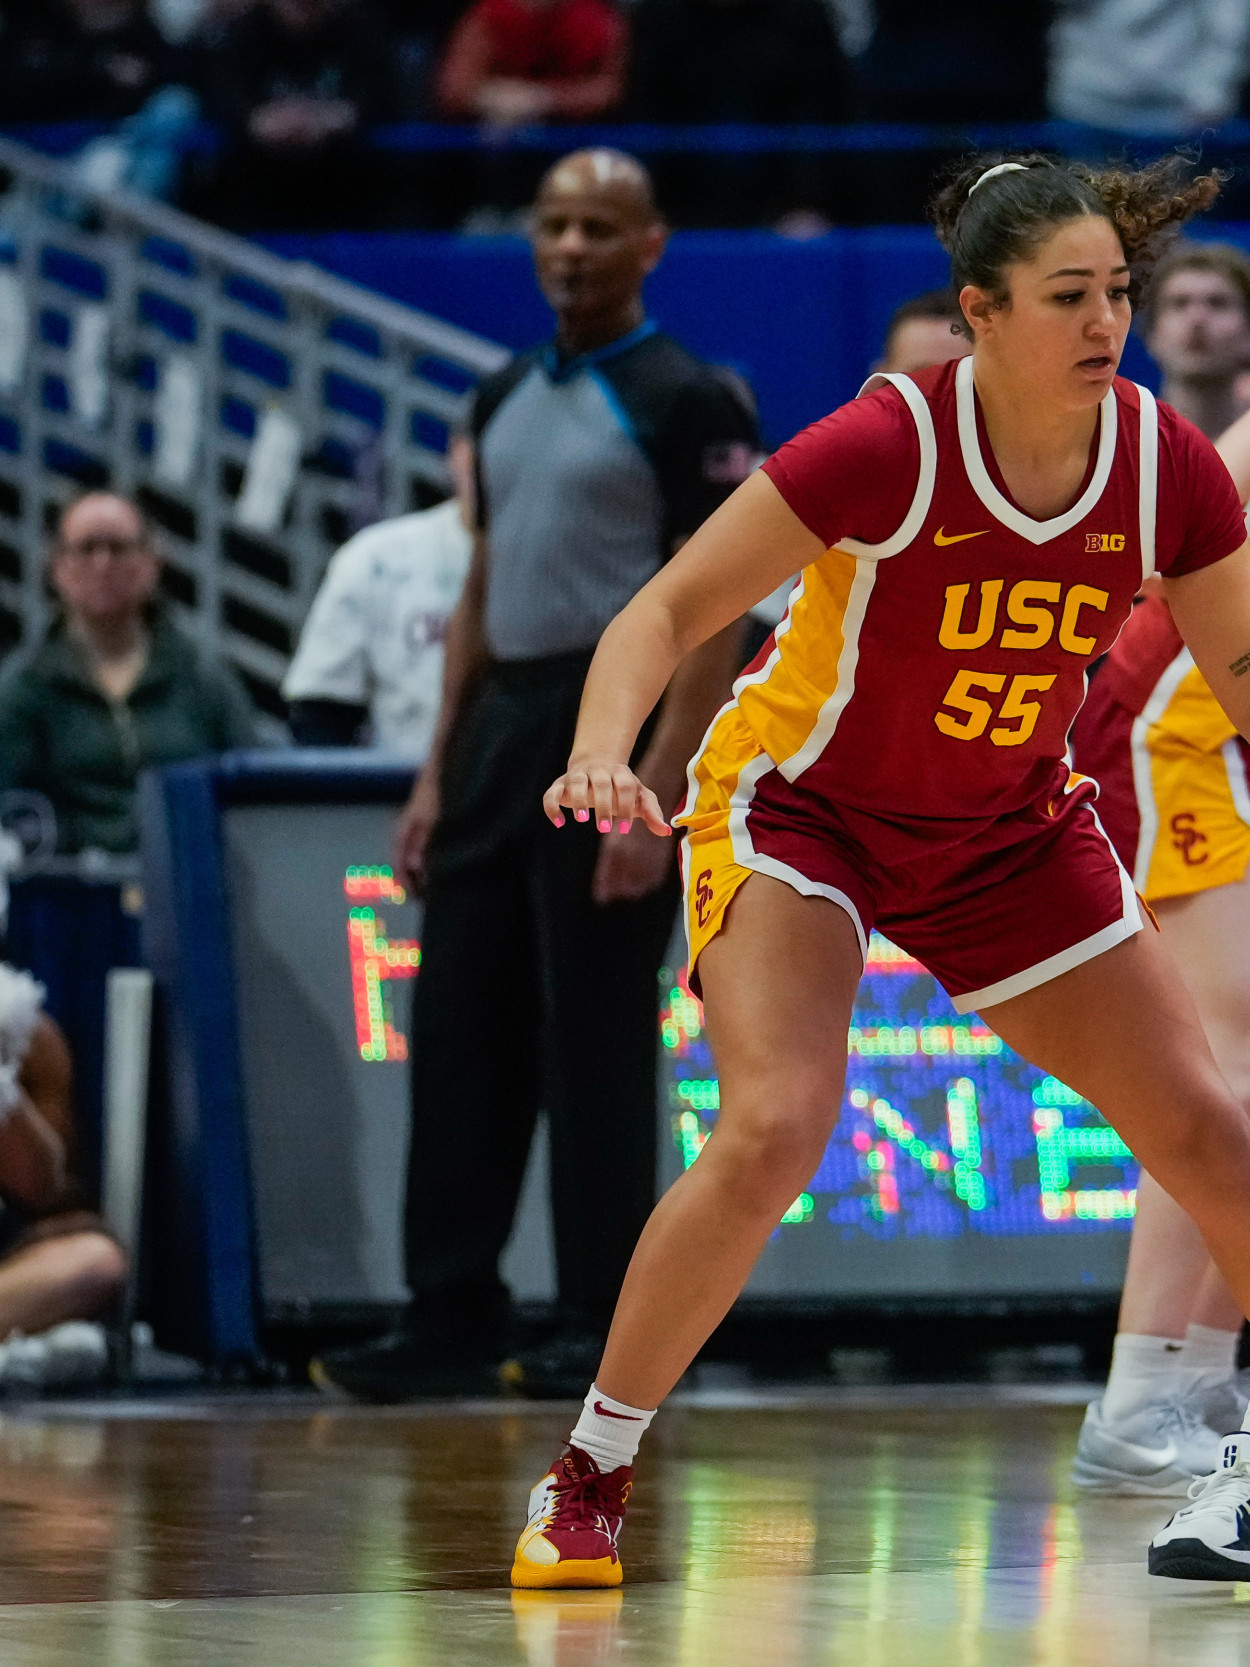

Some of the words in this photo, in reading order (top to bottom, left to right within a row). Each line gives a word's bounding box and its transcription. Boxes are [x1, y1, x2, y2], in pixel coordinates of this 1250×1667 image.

[938, 579, 1109, 655] USC
[934, 669, 1058, 746] 55
[1171, 812, 1209, 867] SC
